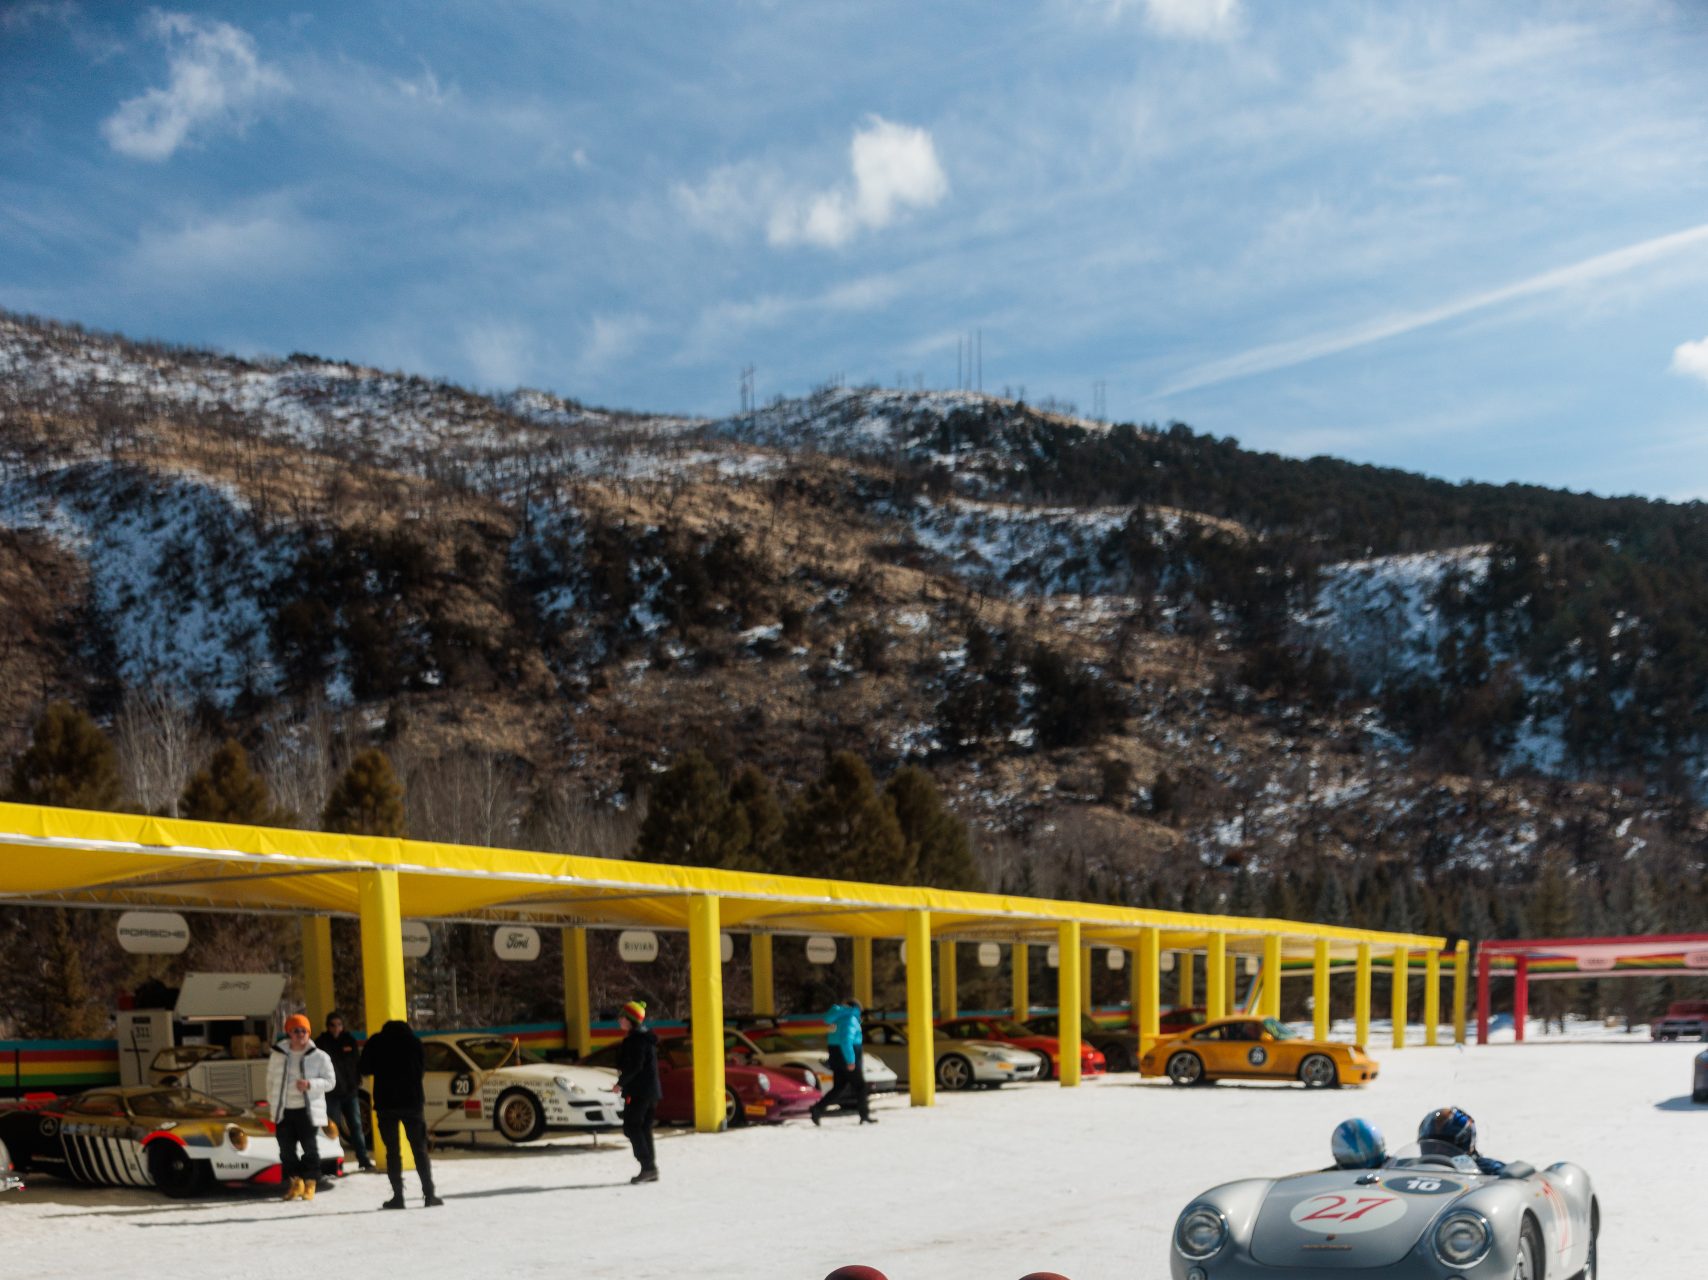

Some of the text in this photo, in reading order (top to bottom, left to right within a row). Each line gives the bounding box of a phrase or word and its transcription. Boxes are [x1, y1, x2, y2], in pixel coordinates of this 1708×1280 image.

[119, 928, 187, 939] PORSCHE
[506, 932, 530, 949] Ford
[624, 942, 655, 951] RIVIAN
[455, 1080, 469, 1094] 20
[1297, 1195, 1398, 1223] 27
